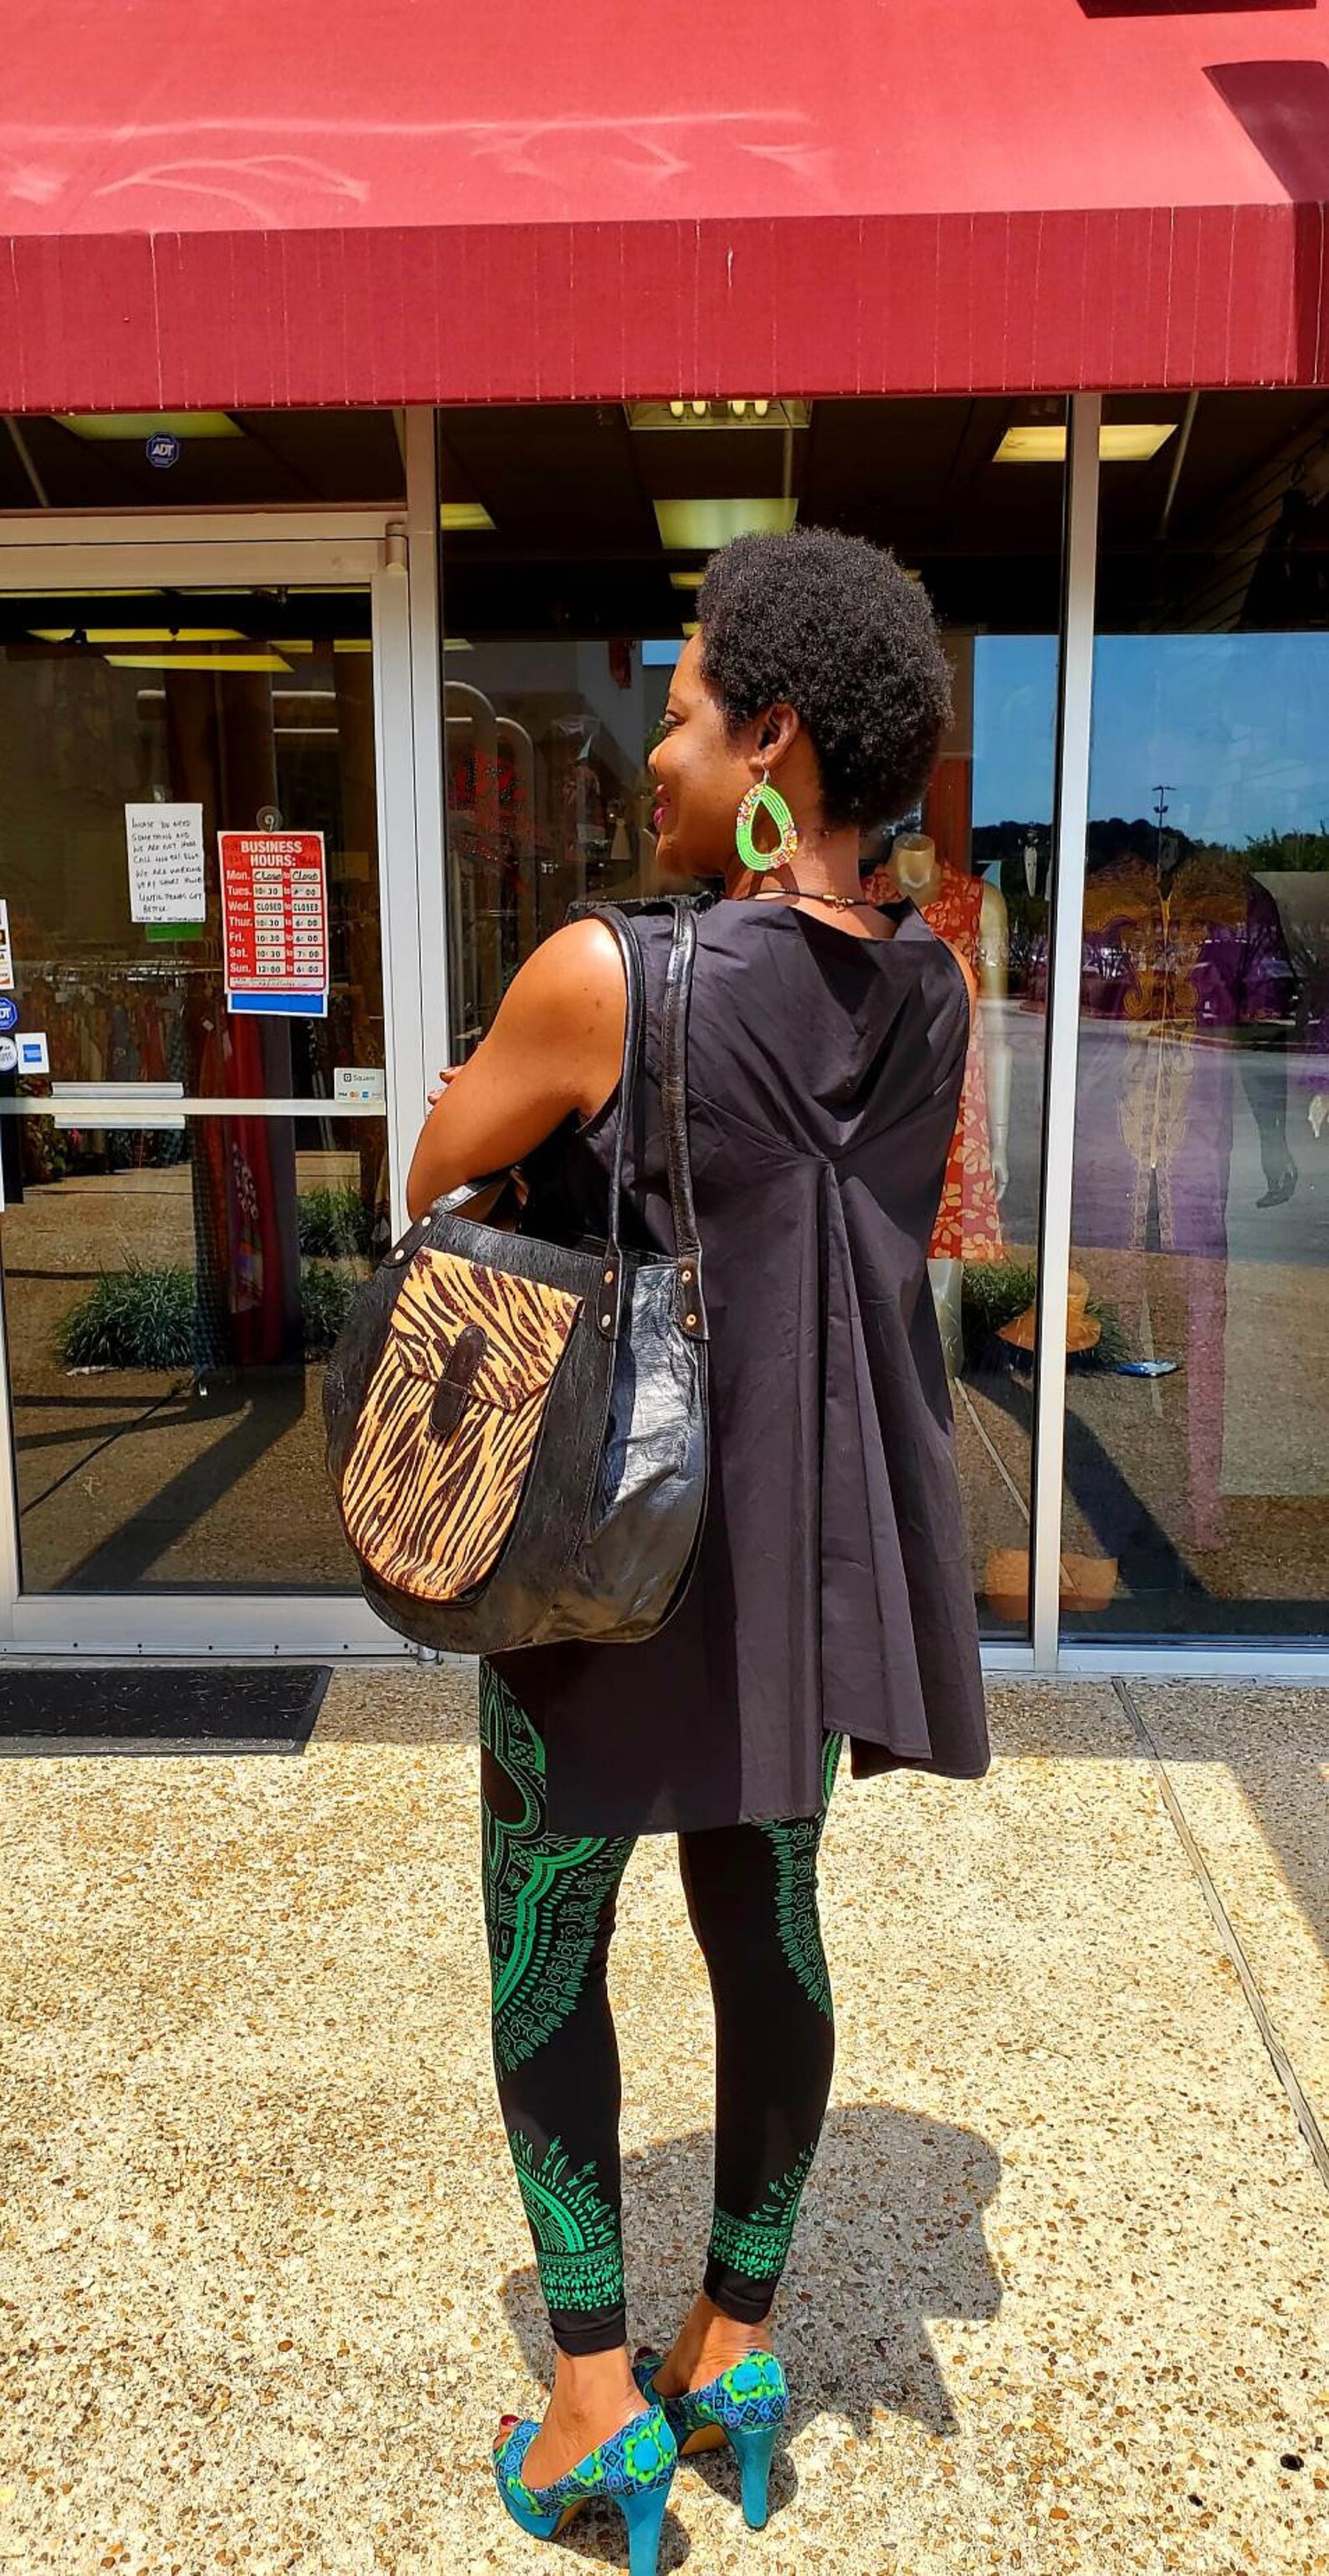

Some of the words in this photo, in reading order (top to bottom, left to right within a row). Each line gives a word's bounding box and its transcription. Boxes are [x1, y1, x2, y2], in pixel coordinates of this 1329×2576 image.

[151, 443, 174, 457] ADT
[240, 841, 302, 853] BUSINESS
[250, 854, 296, 867] HOURS:
[227, 870, 251, 881] Mon.
[227, 885, 251, 896] Tues.
[228, 901, 252, 912] Wed.
[256, 903, 282, 912] CLOSED
[293, 903, 319, 912] CLOSED
[228, 916, 254, 927] Thur.
[229, 931, 245, 943] Fri.
[229, 947, 249, 958] Sat.
[230, 962, 251, 973] Sun.
[0, 1007, 12, 1019] DT
